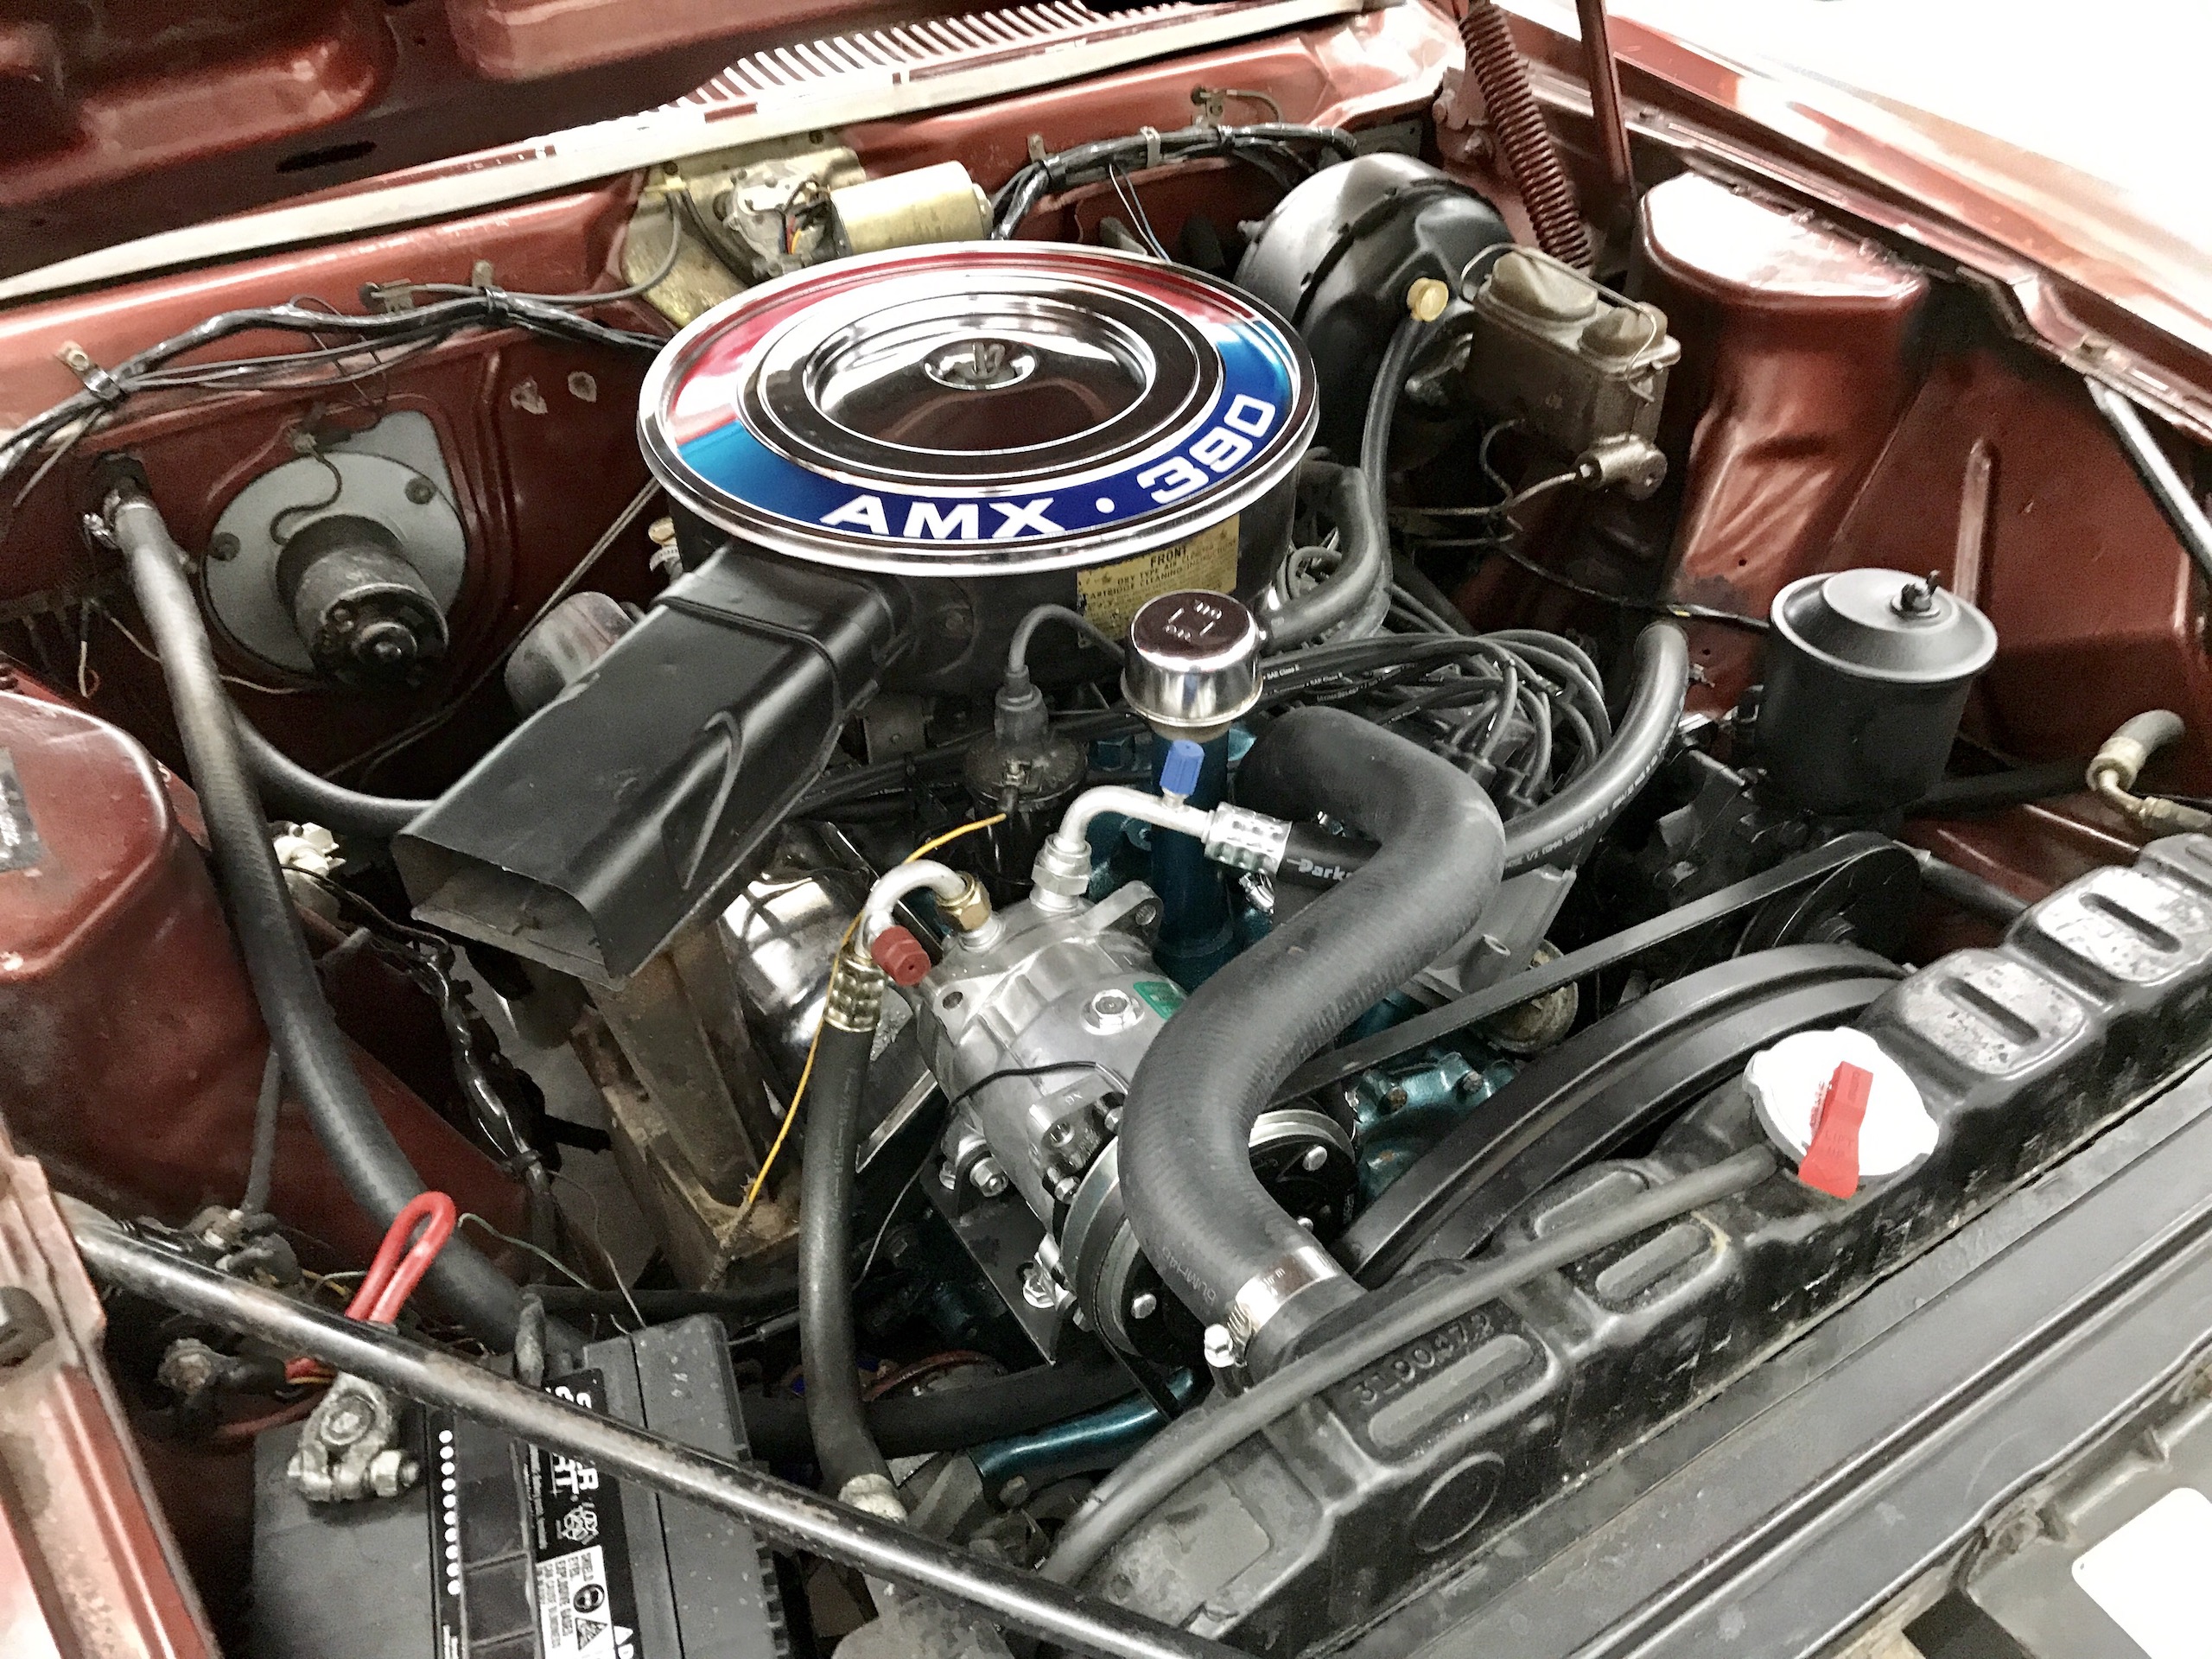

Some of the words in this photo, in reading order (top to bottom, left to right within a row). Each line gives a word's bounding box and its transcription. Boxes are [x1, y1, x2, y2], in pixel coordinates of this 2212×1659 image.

[819, 494, 1066, 540] AMX
[1135, 392, 1277, 505] 390
[1150, 543, 1187, 568] FRONT
